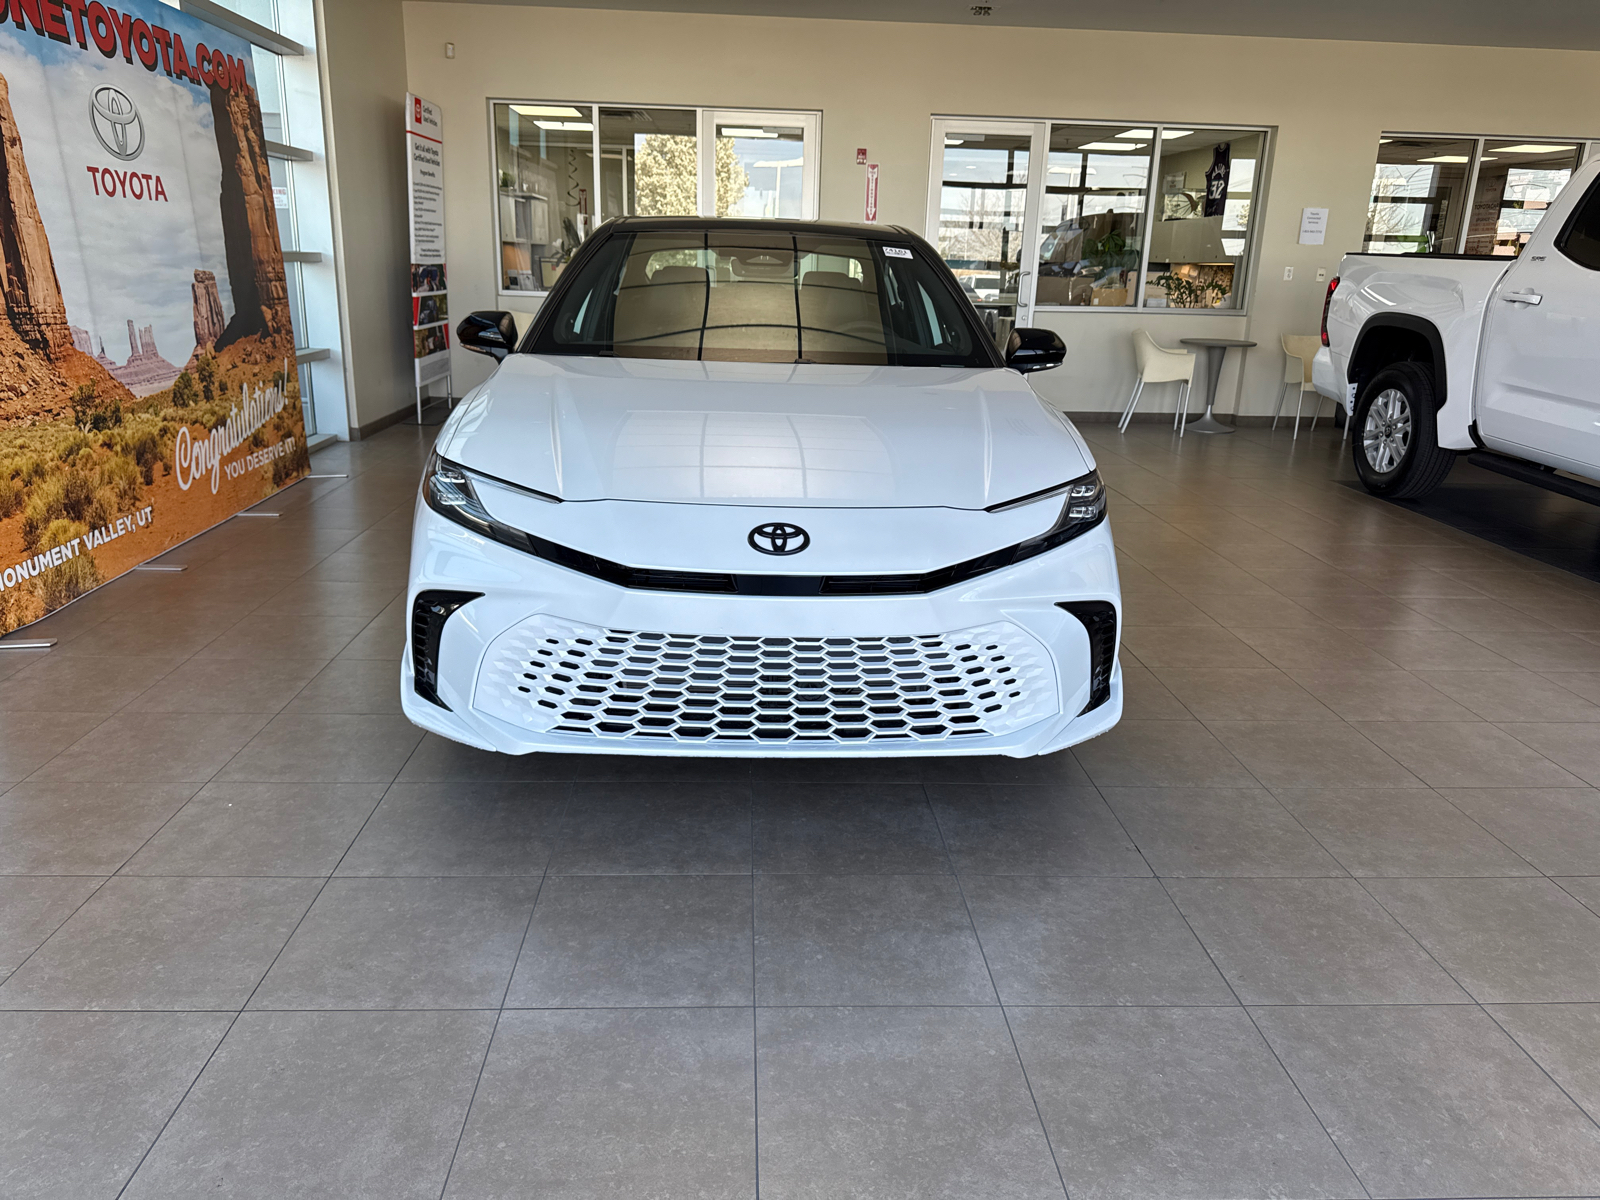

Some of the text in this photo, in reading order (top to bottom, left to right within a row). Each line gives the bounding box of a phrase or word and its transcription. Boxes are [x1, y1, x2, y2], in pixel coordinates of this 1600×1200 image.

[0, 0, 249, 97] NETOYOTA.COM
[86, 166, 168, 202] TOYOTA
[1209, 181, 1225, 199] 32
[175, 358, 289, 495] Congratulations!
[224, 436, 297, 480] YOU DESERVE IT!
[83, 515, 136, 551] VALLEY,
[136, 506, 152, 527] UT
